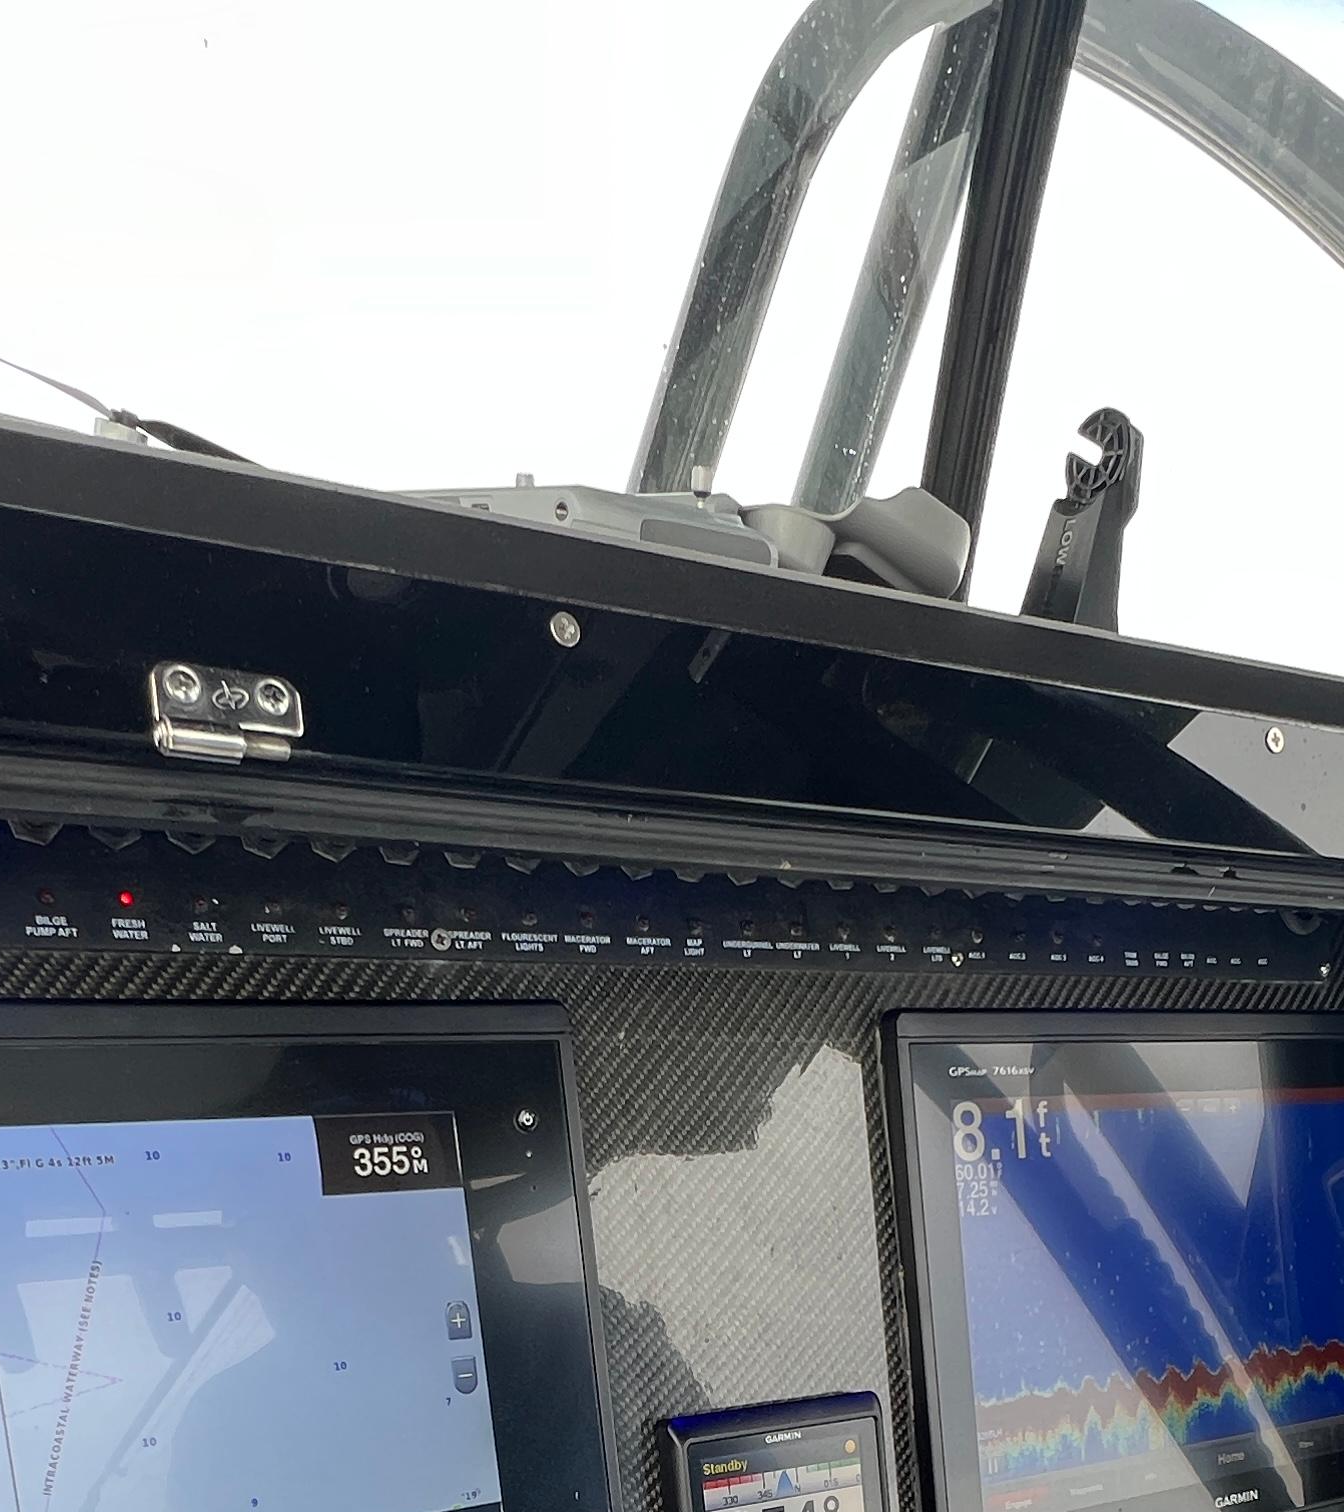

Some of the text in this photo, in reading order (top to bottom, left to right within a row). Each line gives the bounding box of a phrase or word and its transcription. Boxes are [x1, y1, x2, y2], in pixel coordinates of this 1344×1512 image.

[35, 915, 68, 927] BILGE
[111, 918, 146, 929] FRESH
[193, 922, 217, 932] SALT
[251, 923, 296, 934] LIVEWELL
[25, 927, 79, 939] PUMP AFT
[112, 929, 148, 941] WATER
[188, 932, 223, 943] WATER
[262, 934, 288, 944] PORT
[350, 1134, 371, 1145] GPS
[373, 1134, 394, 1145] Hdg
[145, 1150, 160, 1161] 10
[277, 1152, 292, 1162] 10
[167, 1311, 182, 1322] 10
[333, 1360, 348, 1372] 10
[43, 1408, 71, 1496] INTRACOASTAL
[62, 1335, 85, 1403] WATERWAY
[142, 1437, 157, 1448] 10
[765, 1431, 802, 1444] GARMIN
[703, 1459, 749, 1475] Standby
[757, 1489, 773, 1500] 345
[1215, 1489, 1258, 1509] GARMIN
